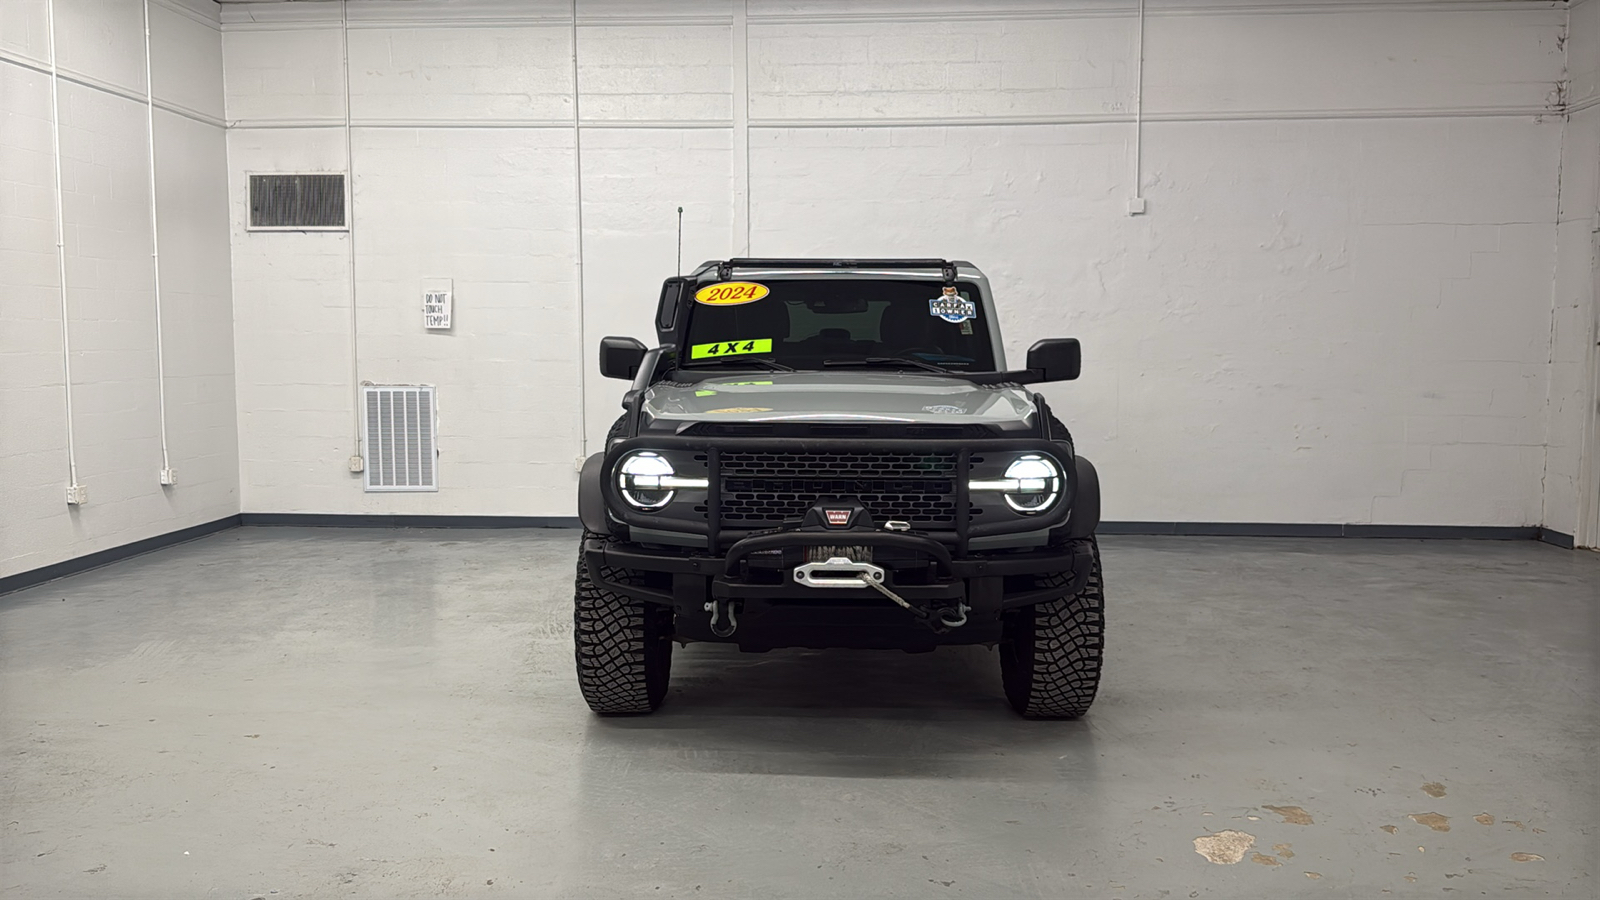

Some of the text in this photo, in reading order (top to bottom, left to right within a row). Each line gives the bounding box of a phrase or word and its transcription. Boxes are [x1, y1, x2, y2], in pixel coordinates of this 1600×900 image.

[425, 293, 447, 304] DO NOT
[706, 286, 757, 301] 2024
[425, 304, 443, 314] TOUCH
[932, 302, 973, 311] CARFAX
[940, 308, 973, 316] OWNER
